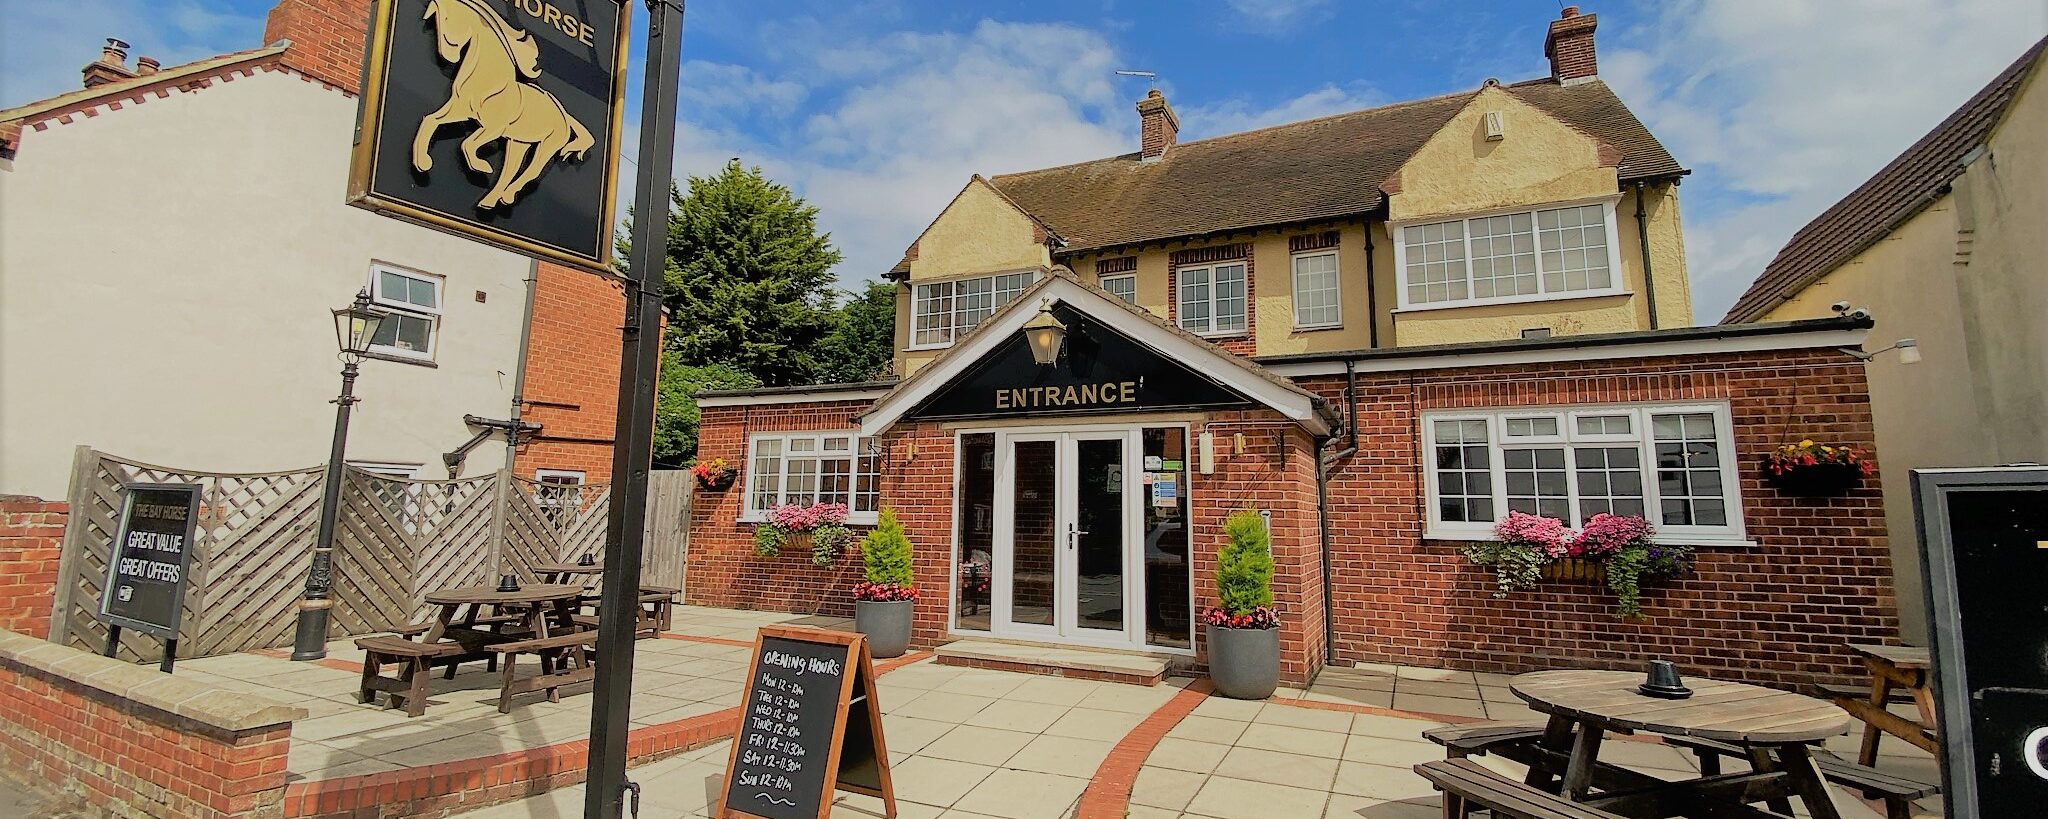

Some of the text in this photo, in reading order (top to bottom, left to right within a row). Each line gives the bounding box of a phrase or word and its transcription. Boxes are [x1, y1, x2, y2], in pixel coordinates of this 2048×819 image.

[996, 381, 1136, 409] ENTRANCE
[135, 503, 188, 520] THE BAY HORSE
[128, 530, 183, 553] GREAT VALUE
[119, 557, 181, 583] GREAT OFFERS
[808, 657, 841, 677] HOURS
[742, 749, 762, 766] SAT
